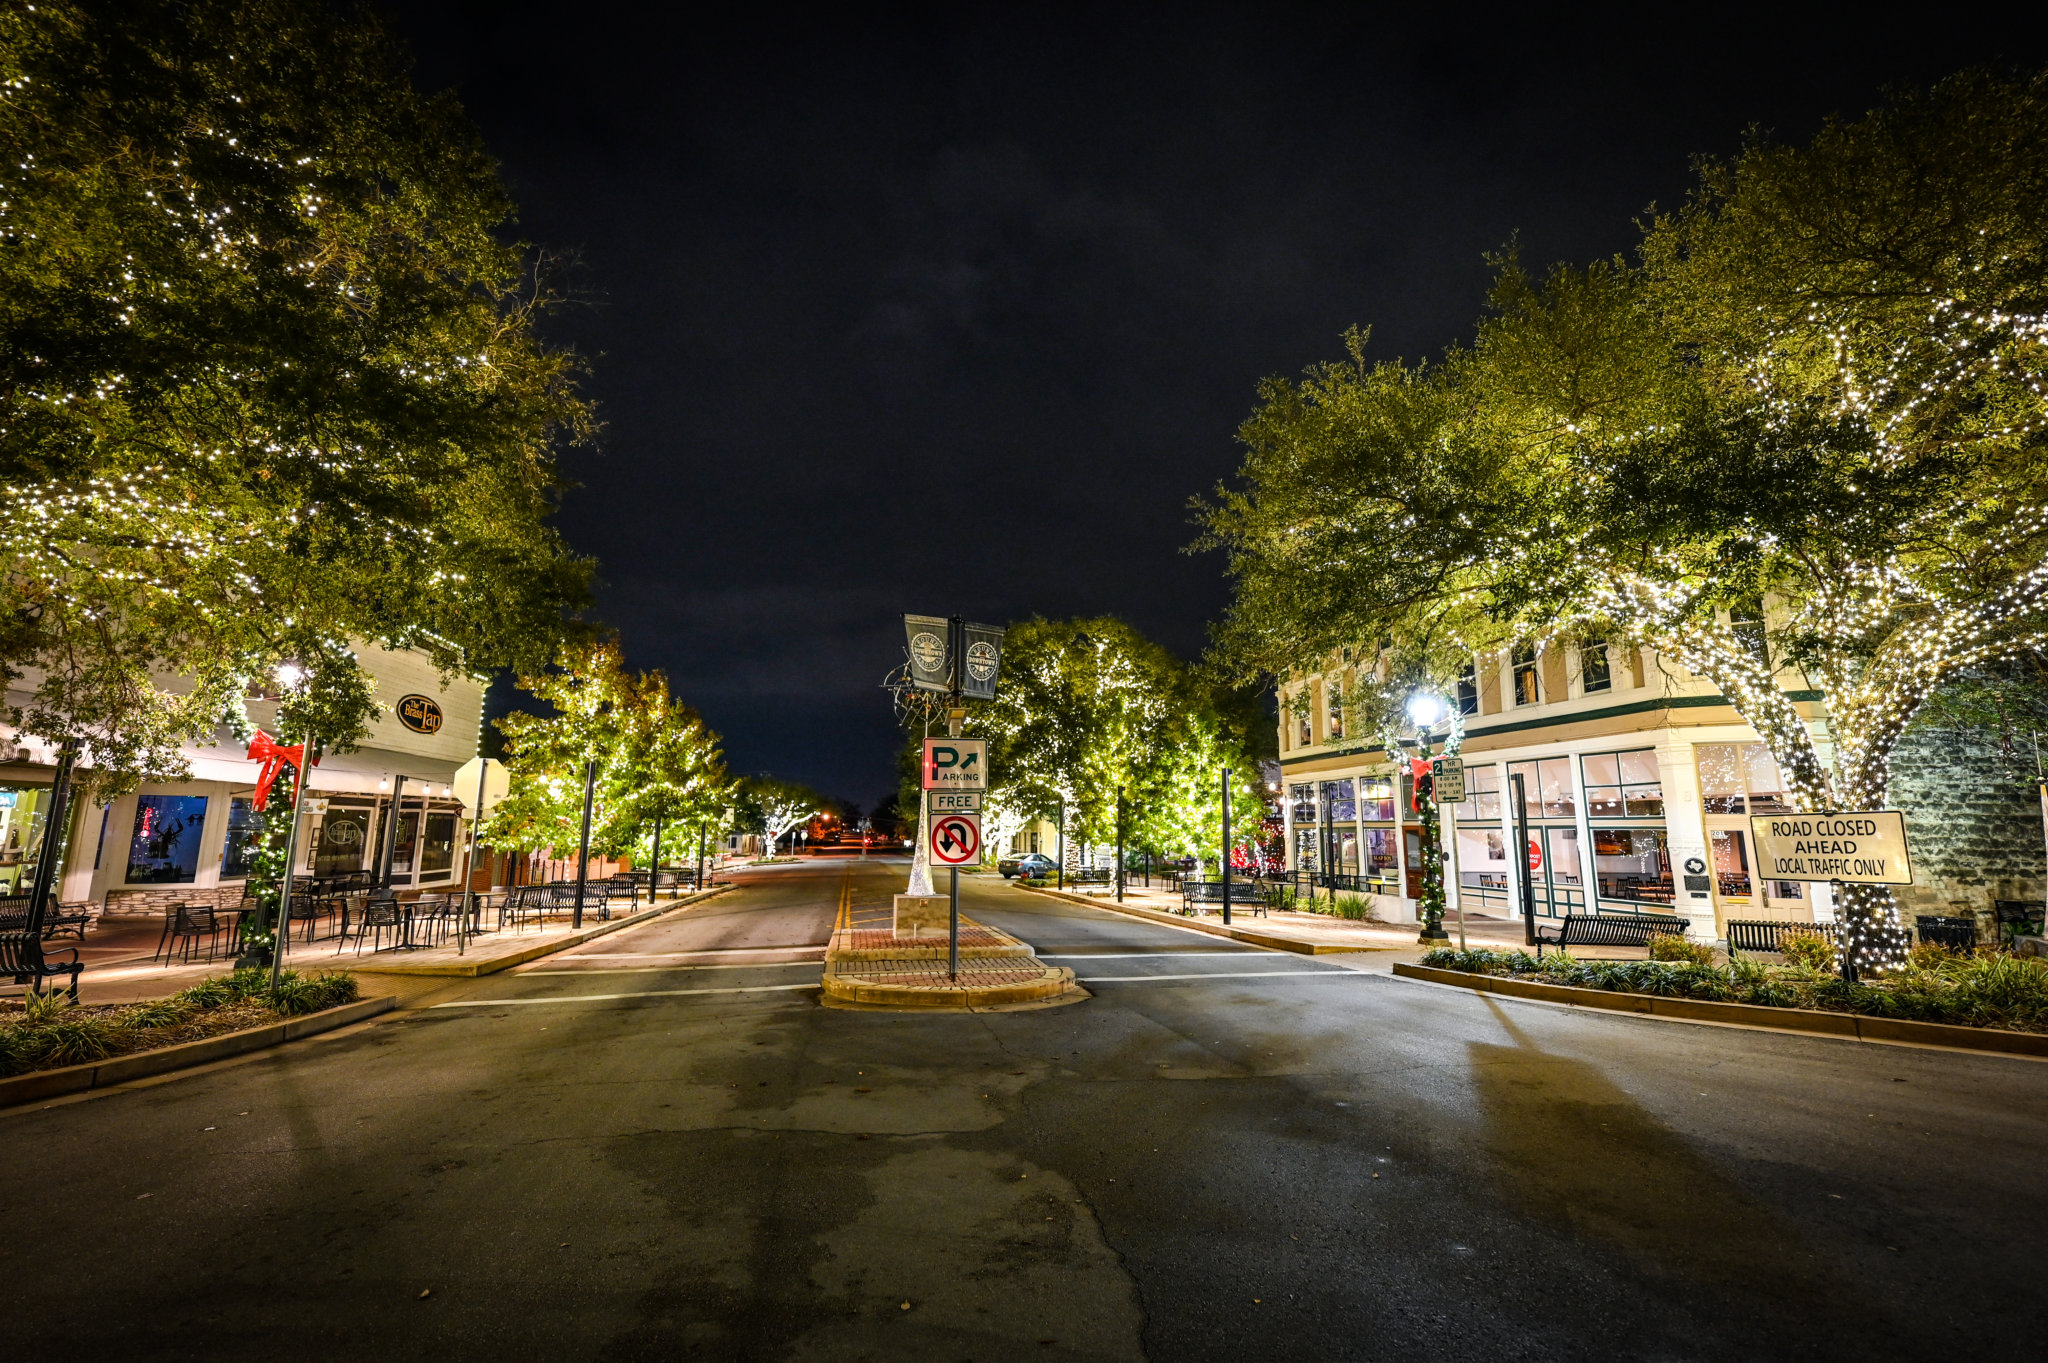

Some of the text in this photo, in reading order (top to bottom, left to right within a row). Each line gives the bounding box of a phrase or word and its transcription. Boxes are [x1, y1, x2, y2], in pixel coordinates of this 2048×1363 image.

[916, 637, 939, 648] ROUND
[913, 648, 943, 657] DOWNTOWN
[973, 647, 994, 657] ROUND
[968, 657, 997, 667] DOWNTOWN
[411, 700, 420, 709] The
[404, 700, 441, 735] Brass Tap
[1434, 763, 1442, 774] 2
[938, 796, 973, 807] FREE
[1772, 820, 1877, 837] ROAD CLOSED
[1795, 840, 1857, 854] AHEAD
[1774, 858, 1885, 876] LOCAL TRAFFIC ONLY
